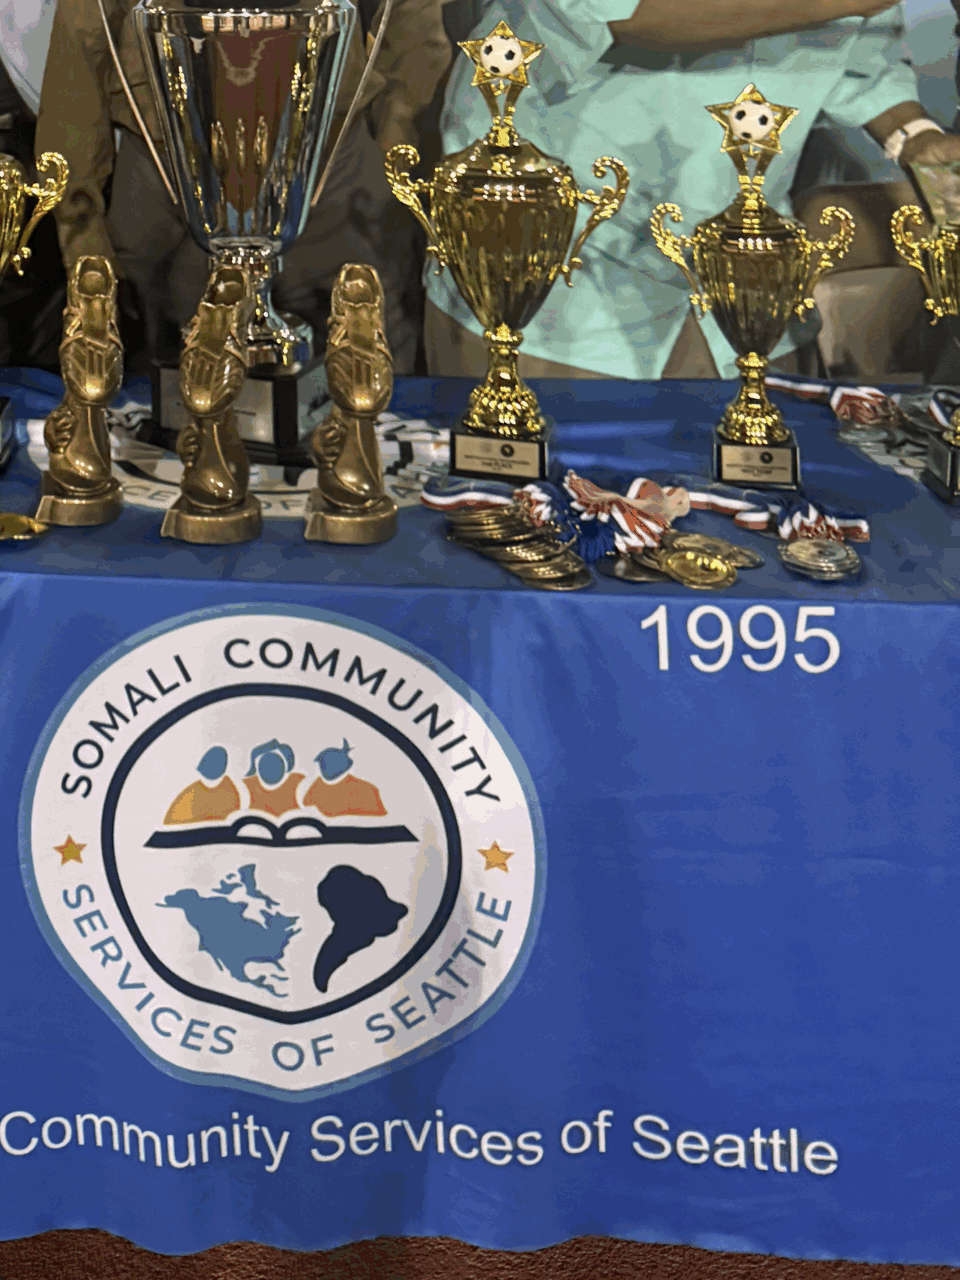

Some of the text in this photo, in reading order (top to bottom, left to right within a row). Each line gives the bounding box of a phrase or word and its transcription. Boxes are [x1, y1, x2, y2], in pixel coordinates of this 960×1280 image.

[641, 604, 840, 674] 1995
[60, 638, 501, 803] SOMALI COMMUNITY
[62, 883, 512, 1071] SERVICES OF SEATTLE
[310, 1109, 544, 1166] Services
[560, 1110, 614, 1154] of
[633, 1114, 839, 1175] Seattle
